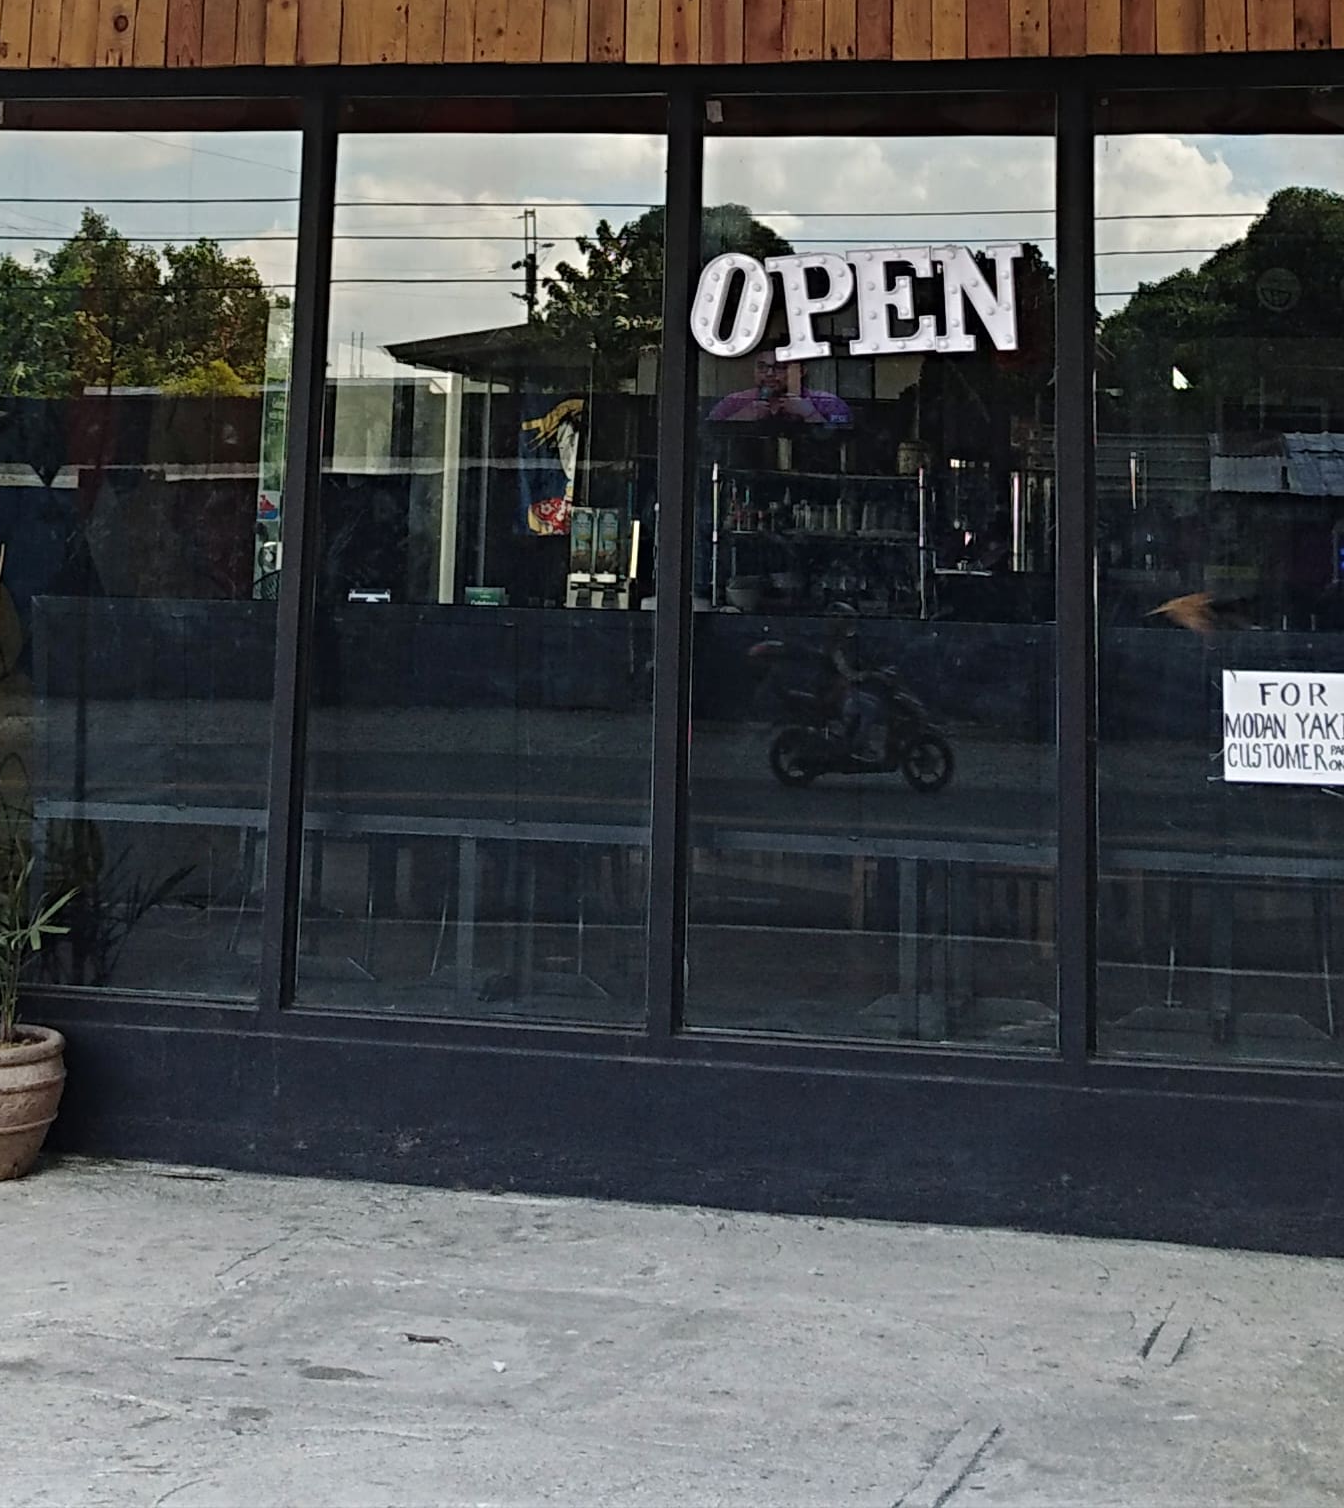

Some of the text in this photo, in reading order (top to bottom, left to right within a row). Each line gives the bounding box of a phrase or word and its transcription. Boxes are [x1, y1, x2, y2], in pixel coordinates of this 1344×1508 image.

[690, 243, 1024, 362] OPEN
[1259, 682, 1328, 707] FOR
[1225, 712, 1287, 739] MODAN
[1227, 742, 1328, 771] CUSTOMER
